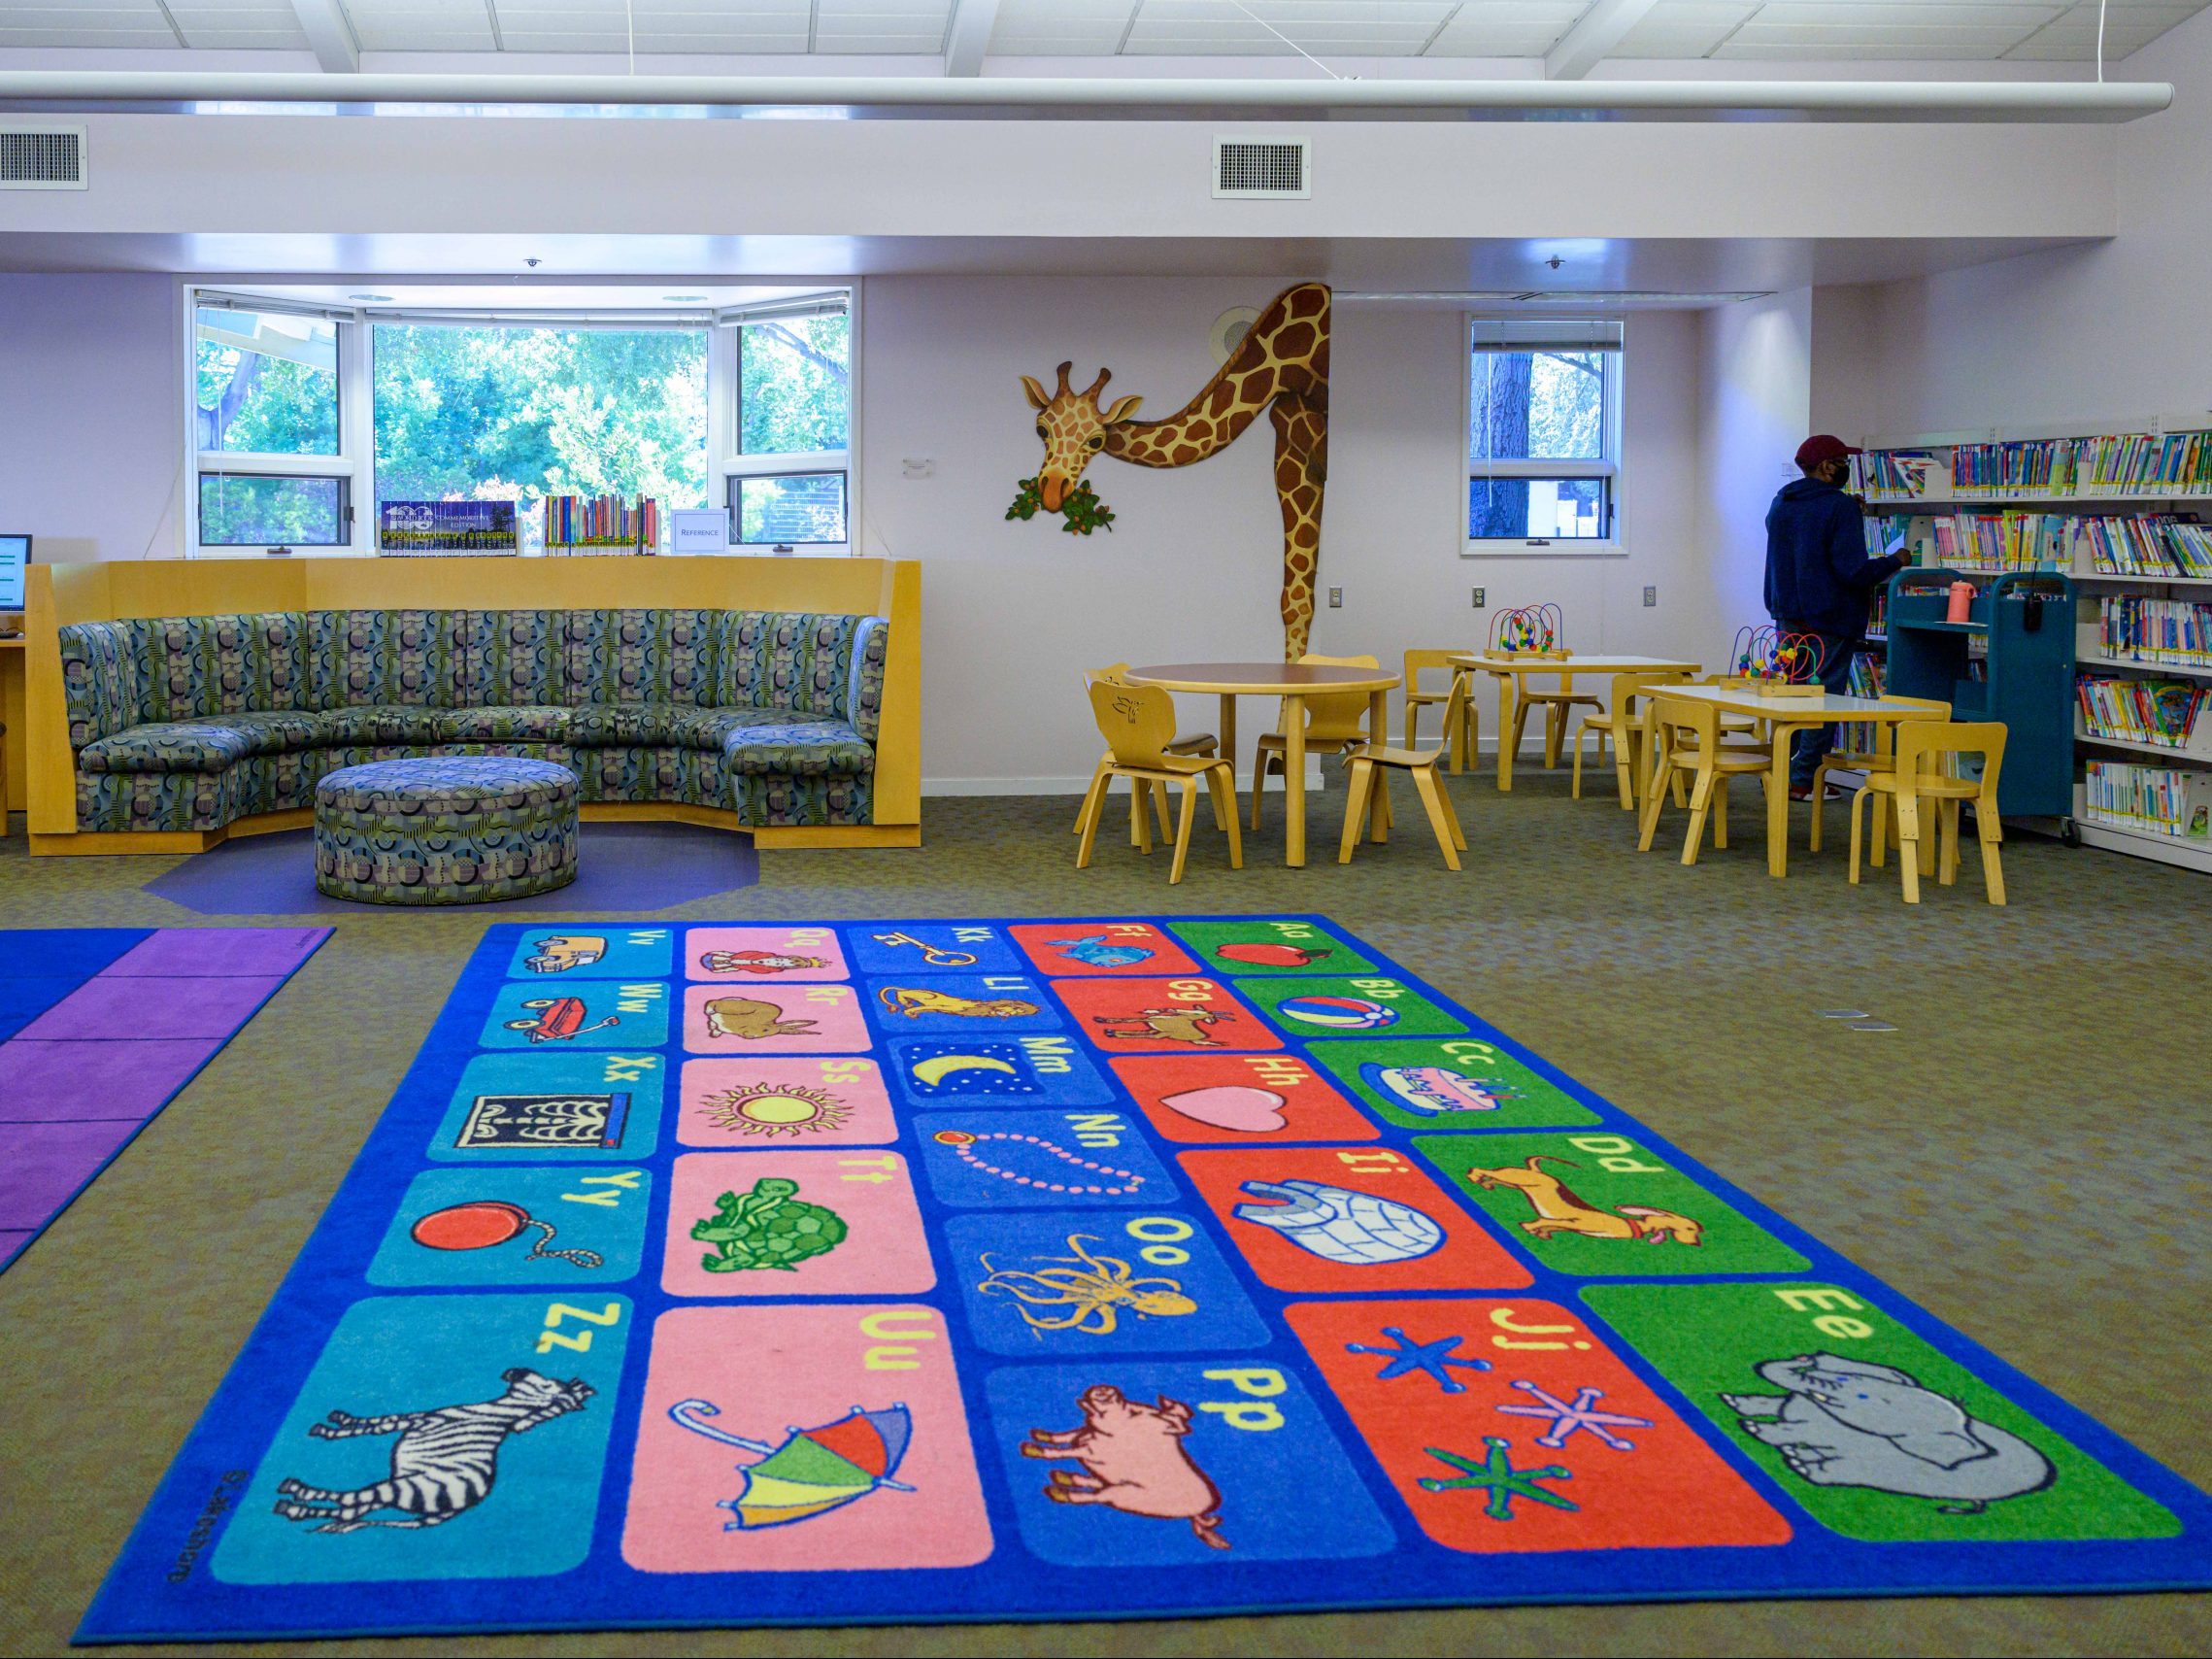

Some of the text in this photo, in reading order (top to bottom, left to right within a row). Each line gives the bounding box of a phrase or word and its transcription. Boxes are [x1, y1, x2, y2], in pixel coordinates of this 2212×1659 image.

[628, 930, 665, 945] Vv
[784, 931, 828, 948] Qq
[952, 927, 993, 943] Kk
[1106, 925, 1152, 937] Ff
[1270, 923, 1312, 938] Aa
[617, 983, 662, 1013] Ww
[807, 987, 848, 1006] Rr
[1167, 979, 1213, 1001] Gg
[1351, 979, 1404, 999] Bb
[1020, 1037, 1074, 1072] Mm
[1441, 1042, 1494, 1065] Cc
[605, 1056, 655, 1081] Xx
[820, 1061, 871, 1084] Ss
[1244, 1058, 1309, 1086] Hh
[1065, 1114, 1125, 1147] Nn
[1337, 1151, 1409, 1173] Ii
[1569, 1136, 1664, 1172] Dd
[838, 1154, 897, 1185] Tt
[561, 1171, 641, 1206] Yy
[1125, 1216, 1194, 1266] Oo
[1775, 1289, 1872, 1337] Ee
[537, 1303, 620, 1353] Zz
[858, 1310, 937, 1371] Uu
[1490, 1307, 1591, 1350] Jj
[1199, 1369, 1287, 1431] Pp
